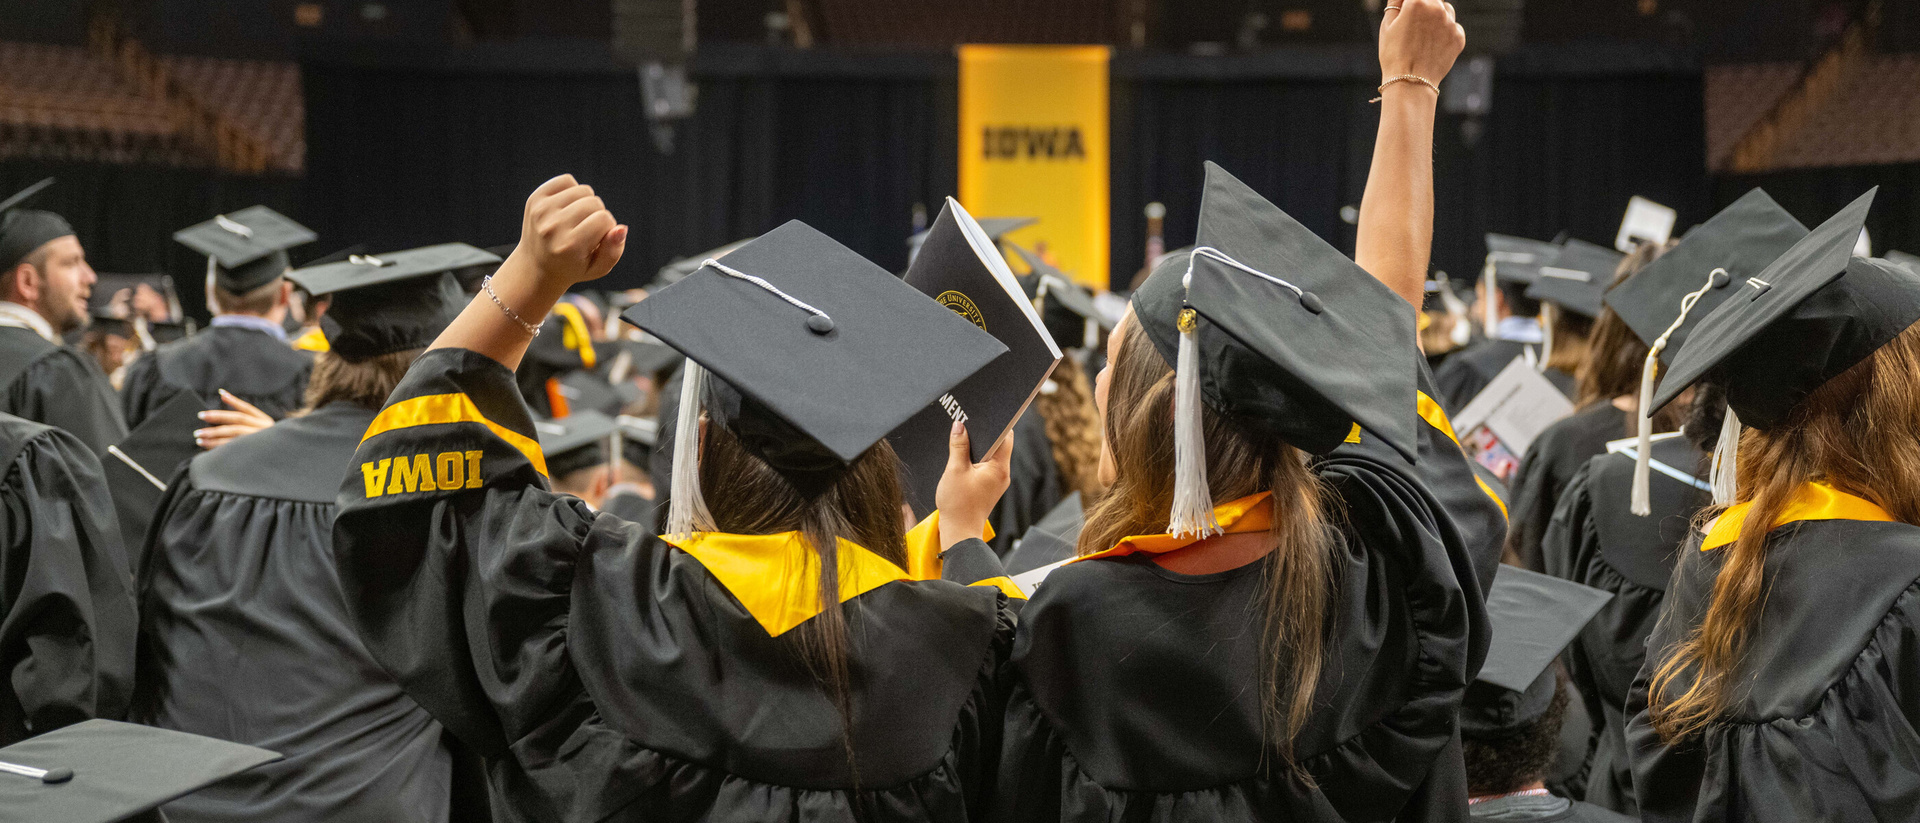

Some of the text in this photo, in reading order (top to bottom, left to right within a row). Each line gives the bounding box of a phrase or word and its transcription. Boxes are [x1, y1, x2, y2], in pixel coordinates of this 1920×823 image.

[983, 127, 1086, 161] IOWA
[947, 294, 982, 323] UNIVERSITY
[361, 449, 483, 499] IOWA
